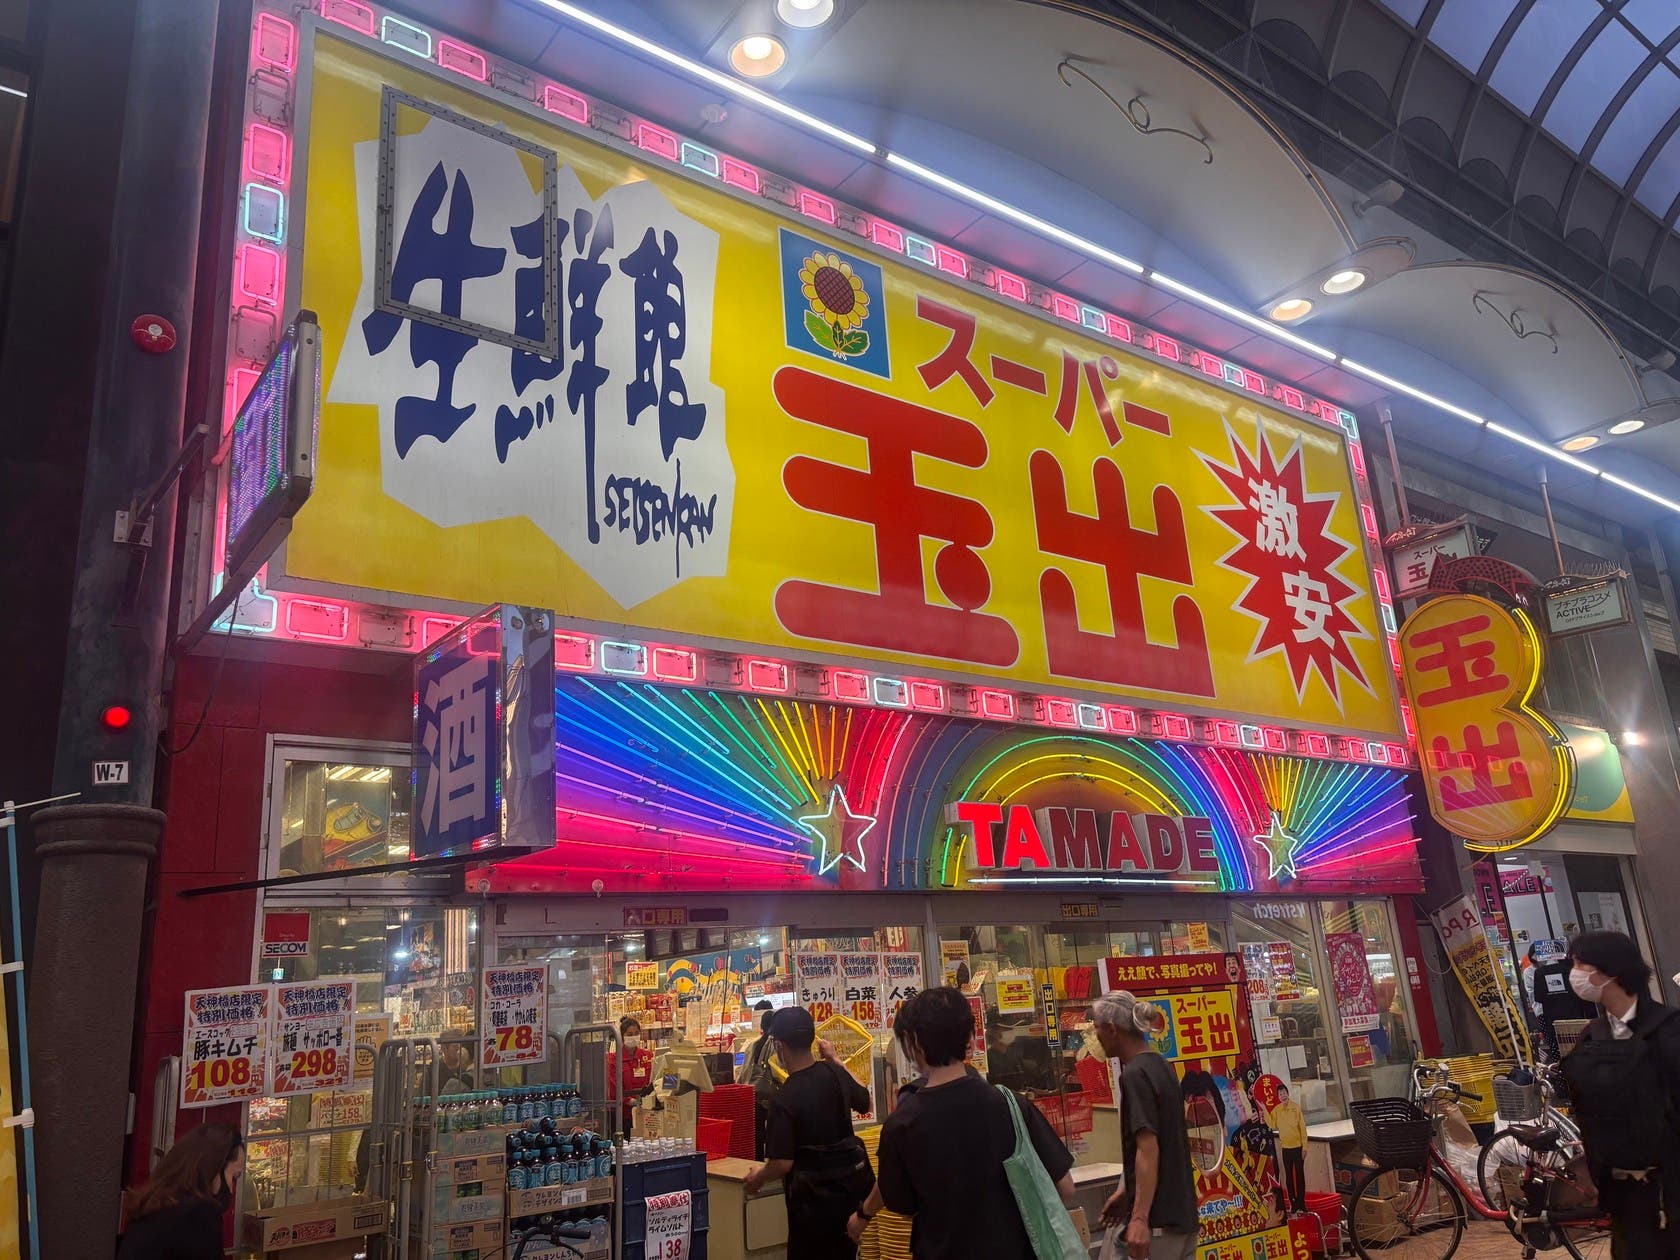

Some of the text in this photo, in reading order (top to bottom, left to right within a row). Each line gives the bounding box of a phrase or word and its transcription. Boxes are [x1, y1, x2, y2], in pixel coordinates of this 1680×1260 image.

[916, 295, 1172, 449] スーパー
[772, 365, 1216, 700] 玉出
[1247, 476, 1336, 650] 激安
[1556, 605, 1592, 619] ACTIVE
[1409, 614, 1533, 811] 玉出
[420, 650, 490, 838] 酒
[95, 763, 125, 783] W-7
[954, 801, 1221, 873] TAMADE
[1503, 878, 1536, 894] ALE
[1061, 904, 1098, 917] 出口専用
[265, 943, 307, 954] SECOM
[196, 992, 263, 1008] 天神橋店限定
[284, 987, 348, 1002] 天神橋店限定
[802, 987, 835, 1002] きゅうり
[846, 986, 877, 1001] 白菜
[889, 986, 919, 1000] 人参
[808, 1002, 833, 1022] 128
[851, 1001, 875, 1021] 158
[1176, 995, 1217, 1014] スーパー
[195, 1028, 230, 1039] エースコック
[284, 1023, 306, 1033] サンヨー
[496, 1025, 533, 1051] 78
[1178, 1011, 1236, 1055] 玉出
[194, 1036, 258, 1061] 豚キムチ
[291, 1048, 337, 1078] 298
[191, 1057, 250, 1090] 108
[1262, 1077, 1274, 1106] まいど
